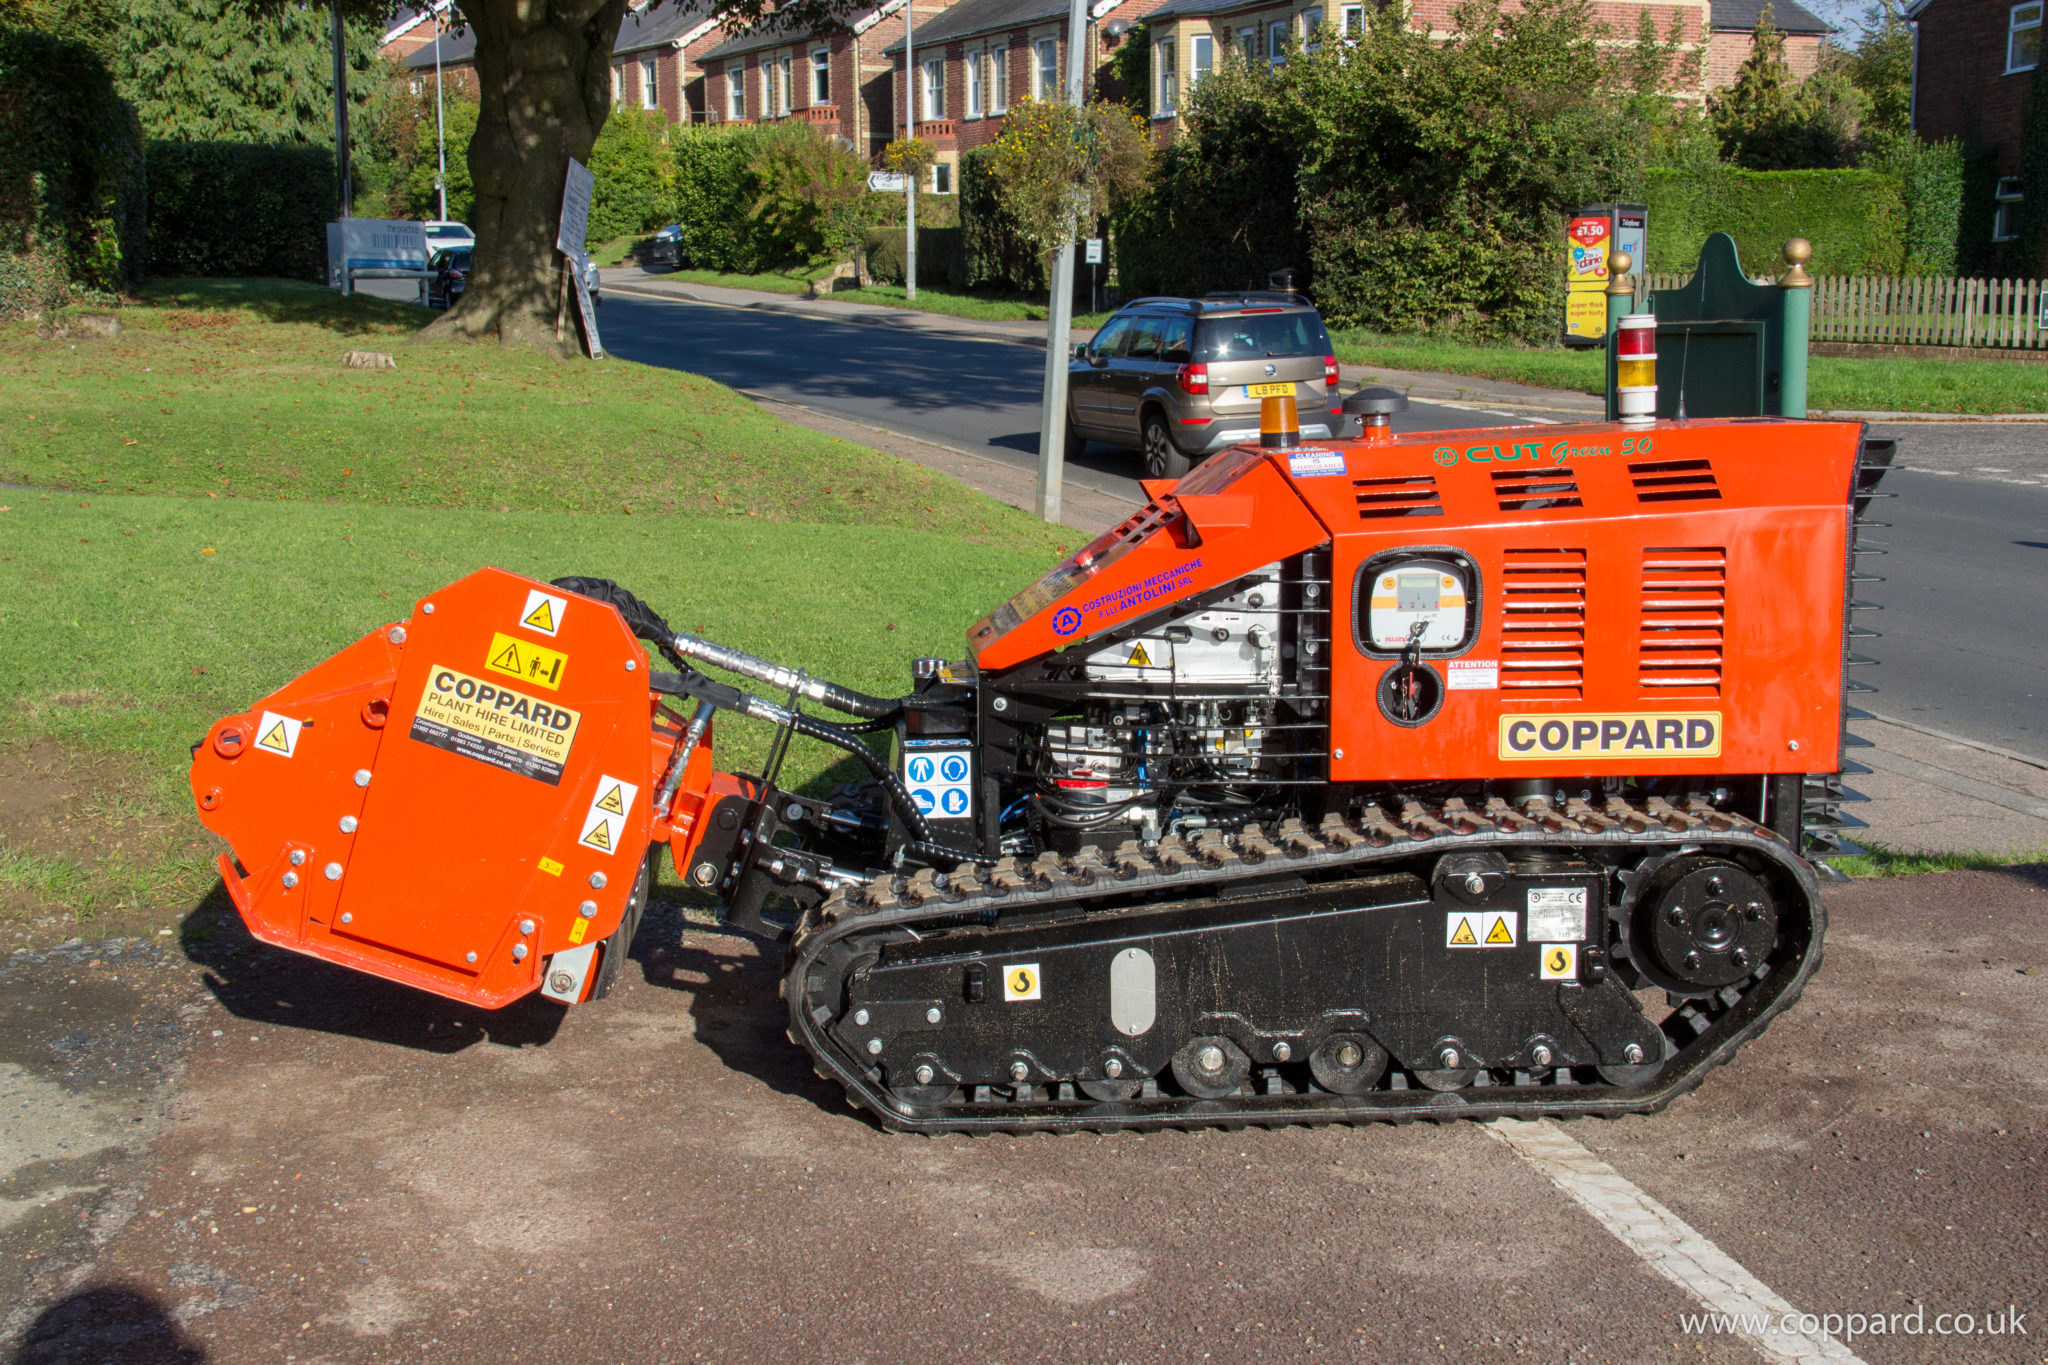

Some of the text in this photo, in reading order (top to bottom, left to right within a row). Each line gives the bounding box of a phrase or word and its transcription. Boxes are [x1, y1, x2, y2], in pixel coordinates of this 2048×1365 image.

[1466, 443, 1544, 462] CUT
[1552, 442, 1612, 464] Green
[1621, 437, 1652, 455] 50
[1082, 558, 1203, 612] COSTRUZIONI MECCANICHE
[1120, 582, 1176, 612] ANTOLINI
[1178, 576, 1193, 588] SRL
[429, 692, 564, 745] PLANT HIRE LIMITED
[435, 671, 572, 731] COPPARD
[424, 706, 560, 758] Hire Sales Parts Service
[1508, 719, 1715, 751] COPPARD
[457, 746, 511, 769] www.coppard.co.uk
